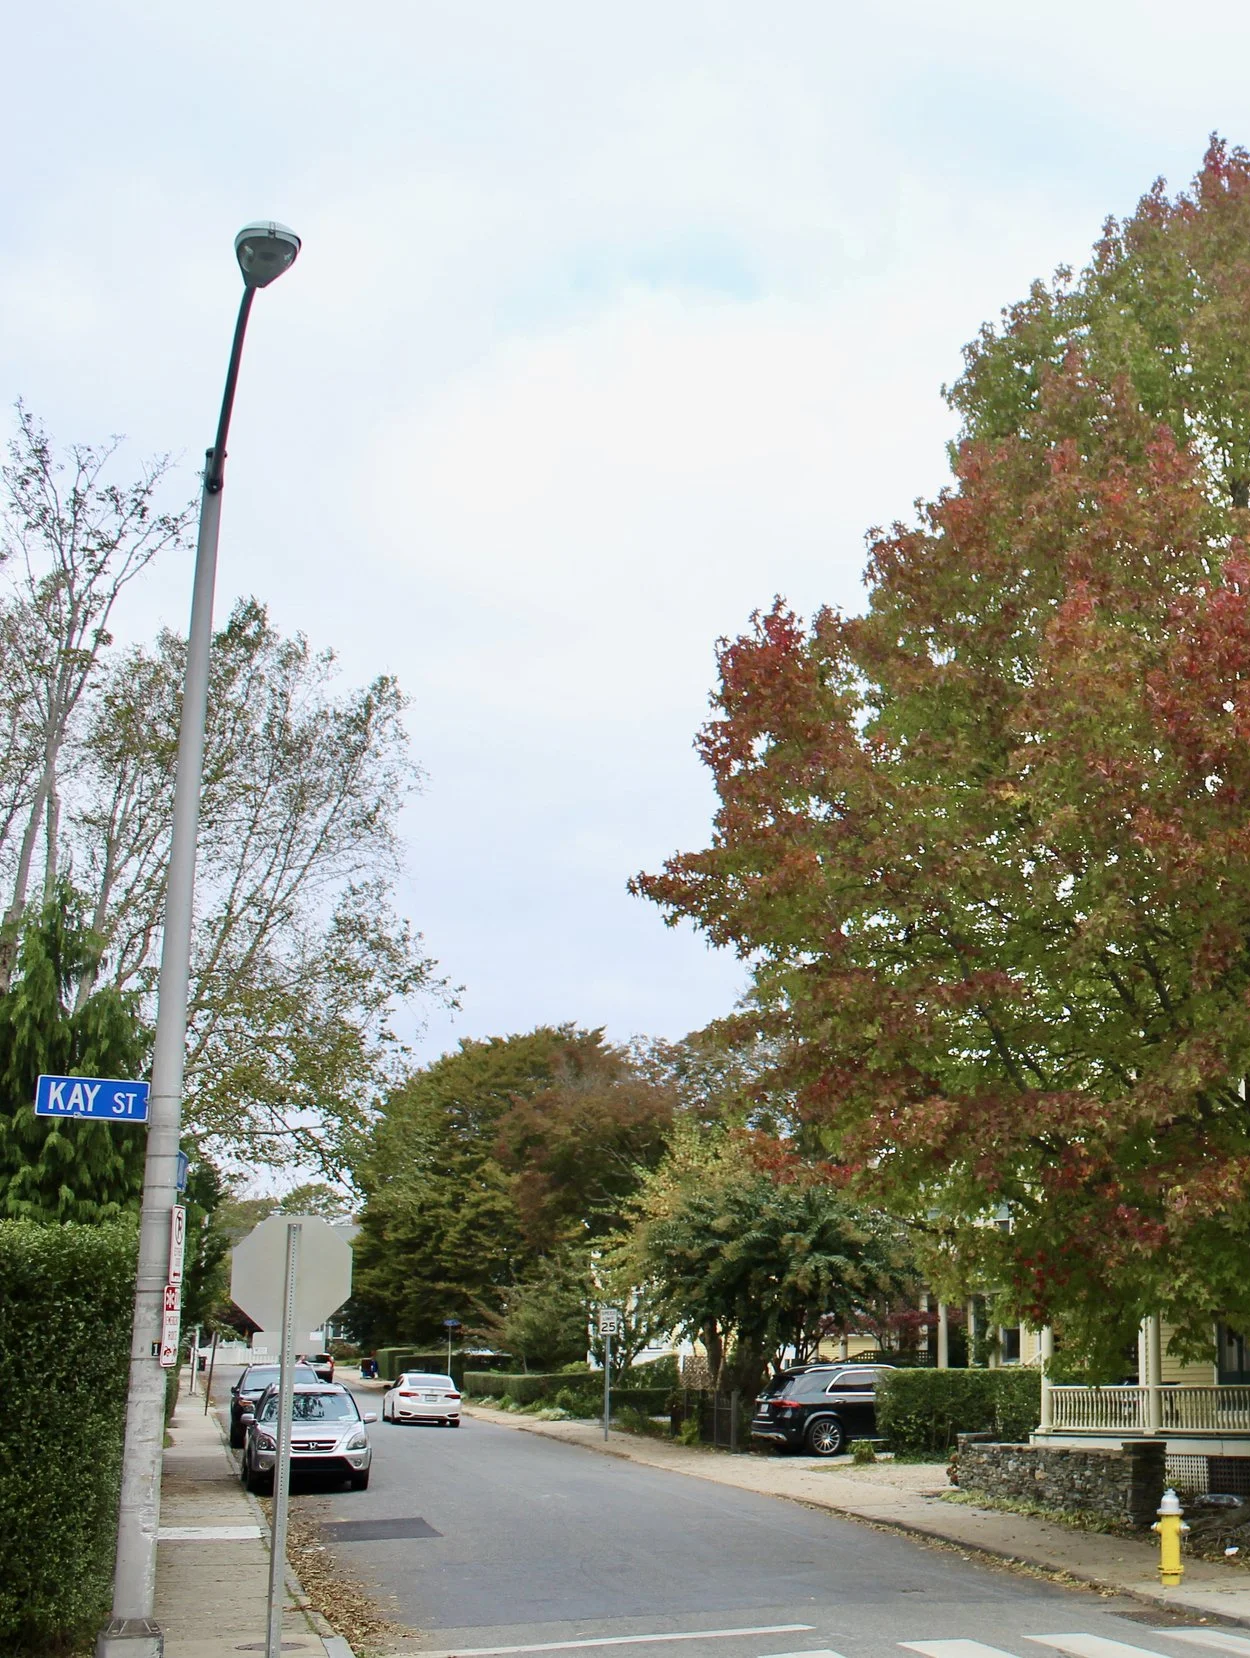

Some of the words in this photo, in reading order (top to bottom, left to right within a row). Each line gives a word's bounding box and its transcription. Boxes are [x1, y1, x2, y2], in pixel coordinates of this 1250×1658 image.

[48, 1081, 101, 1112] KAY
[112, 1092, 138, 1114] ST
[601, 1322, 616, 1332] 25
